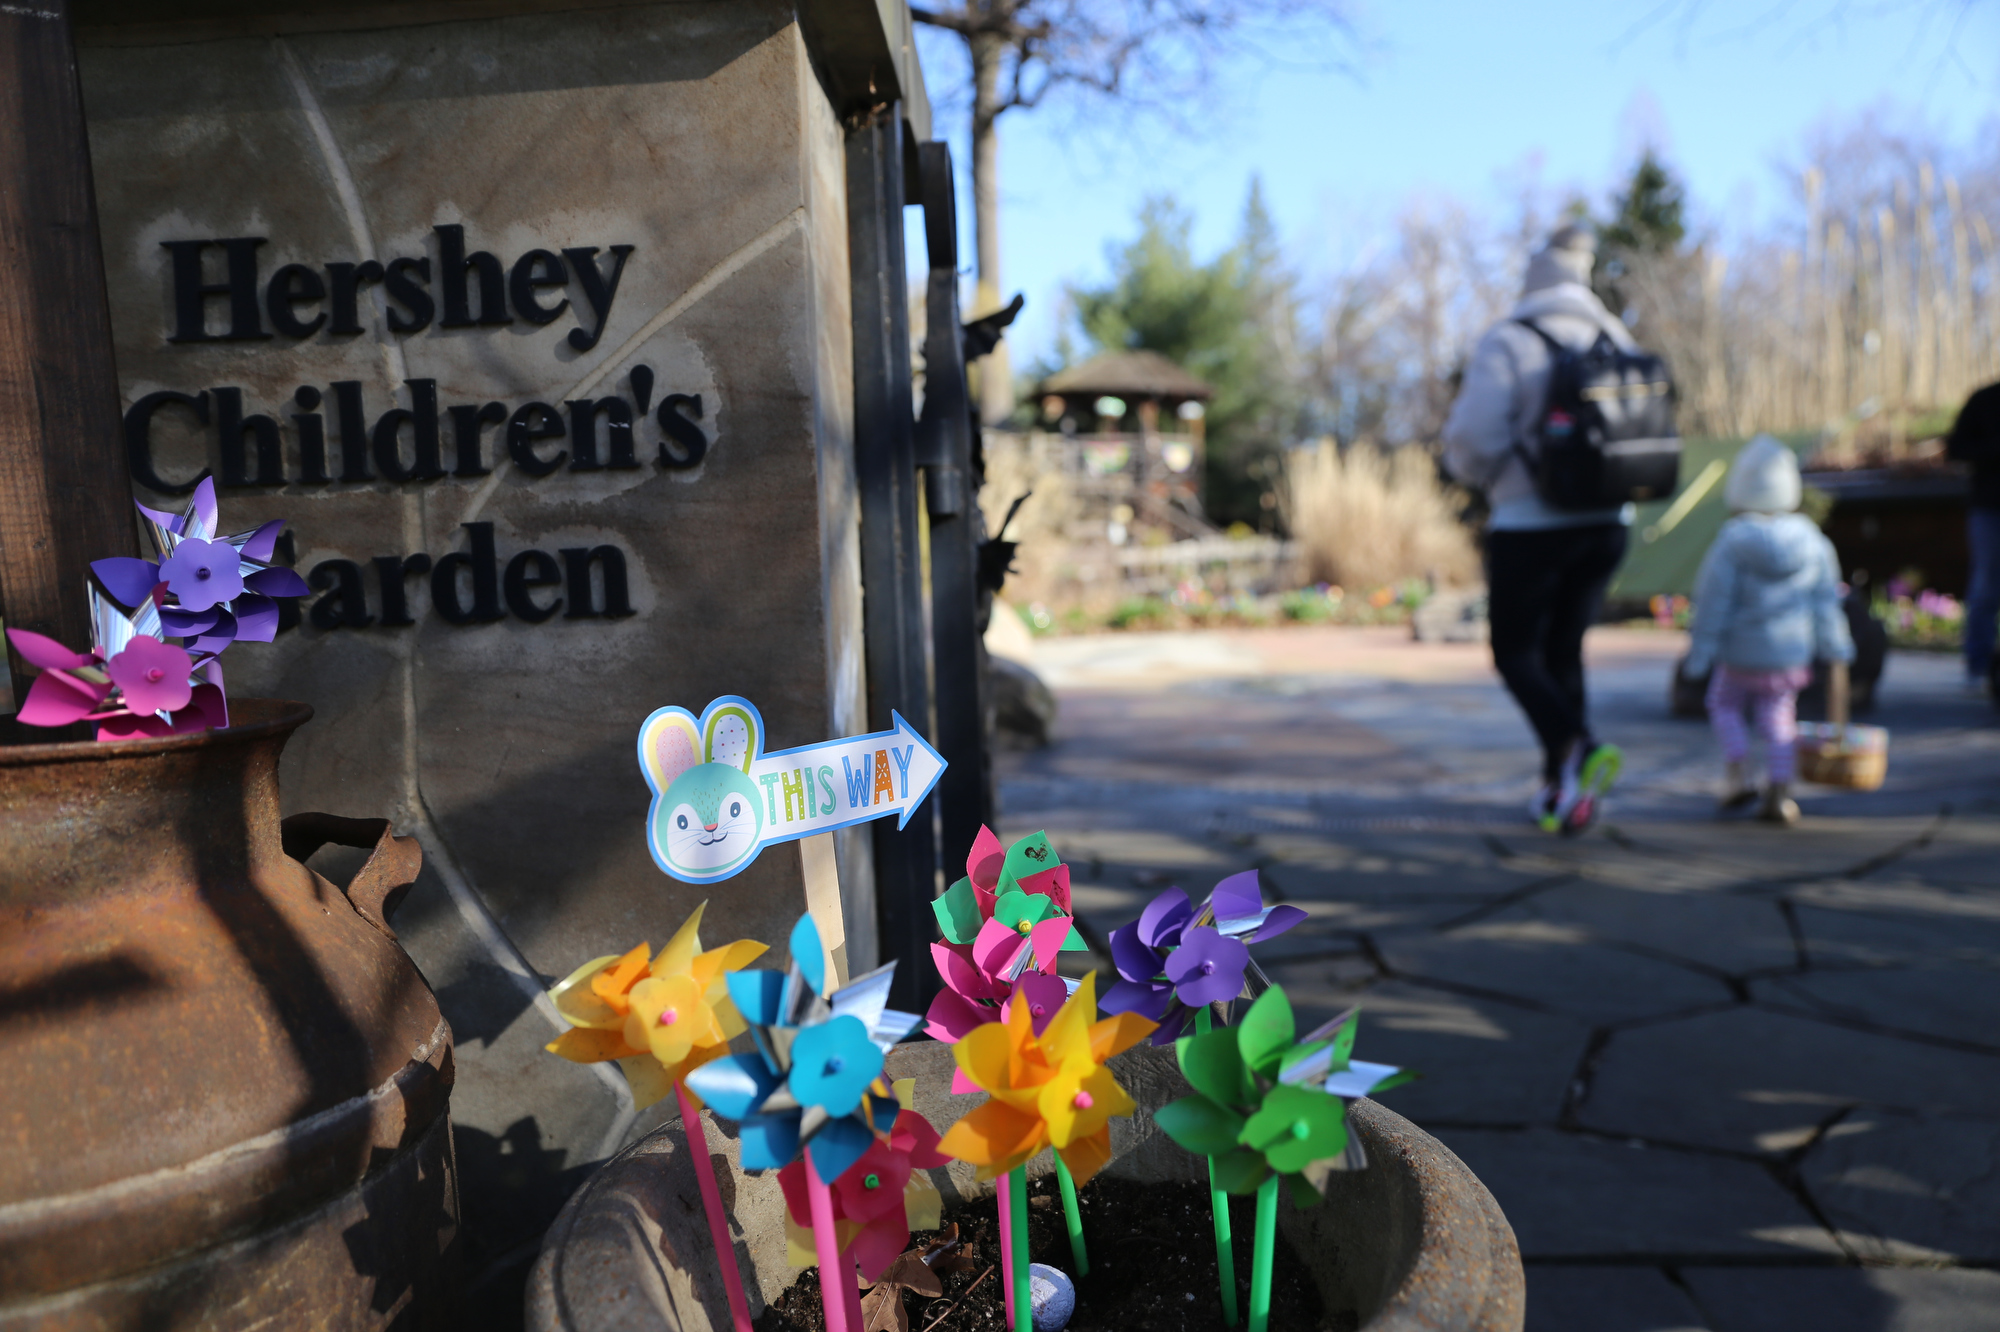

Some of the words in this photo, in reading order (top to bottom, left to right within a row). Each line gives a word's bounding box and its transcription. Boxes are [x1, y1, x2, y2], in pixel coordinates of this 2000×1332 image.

[159, 223, 636, 352] Hershey
[124, 364, 708, 495] Children's
[268, 521, 637, 633] arden
[759, 764, 837, 826] THIS
[841, 744, 914, 809] WAY
